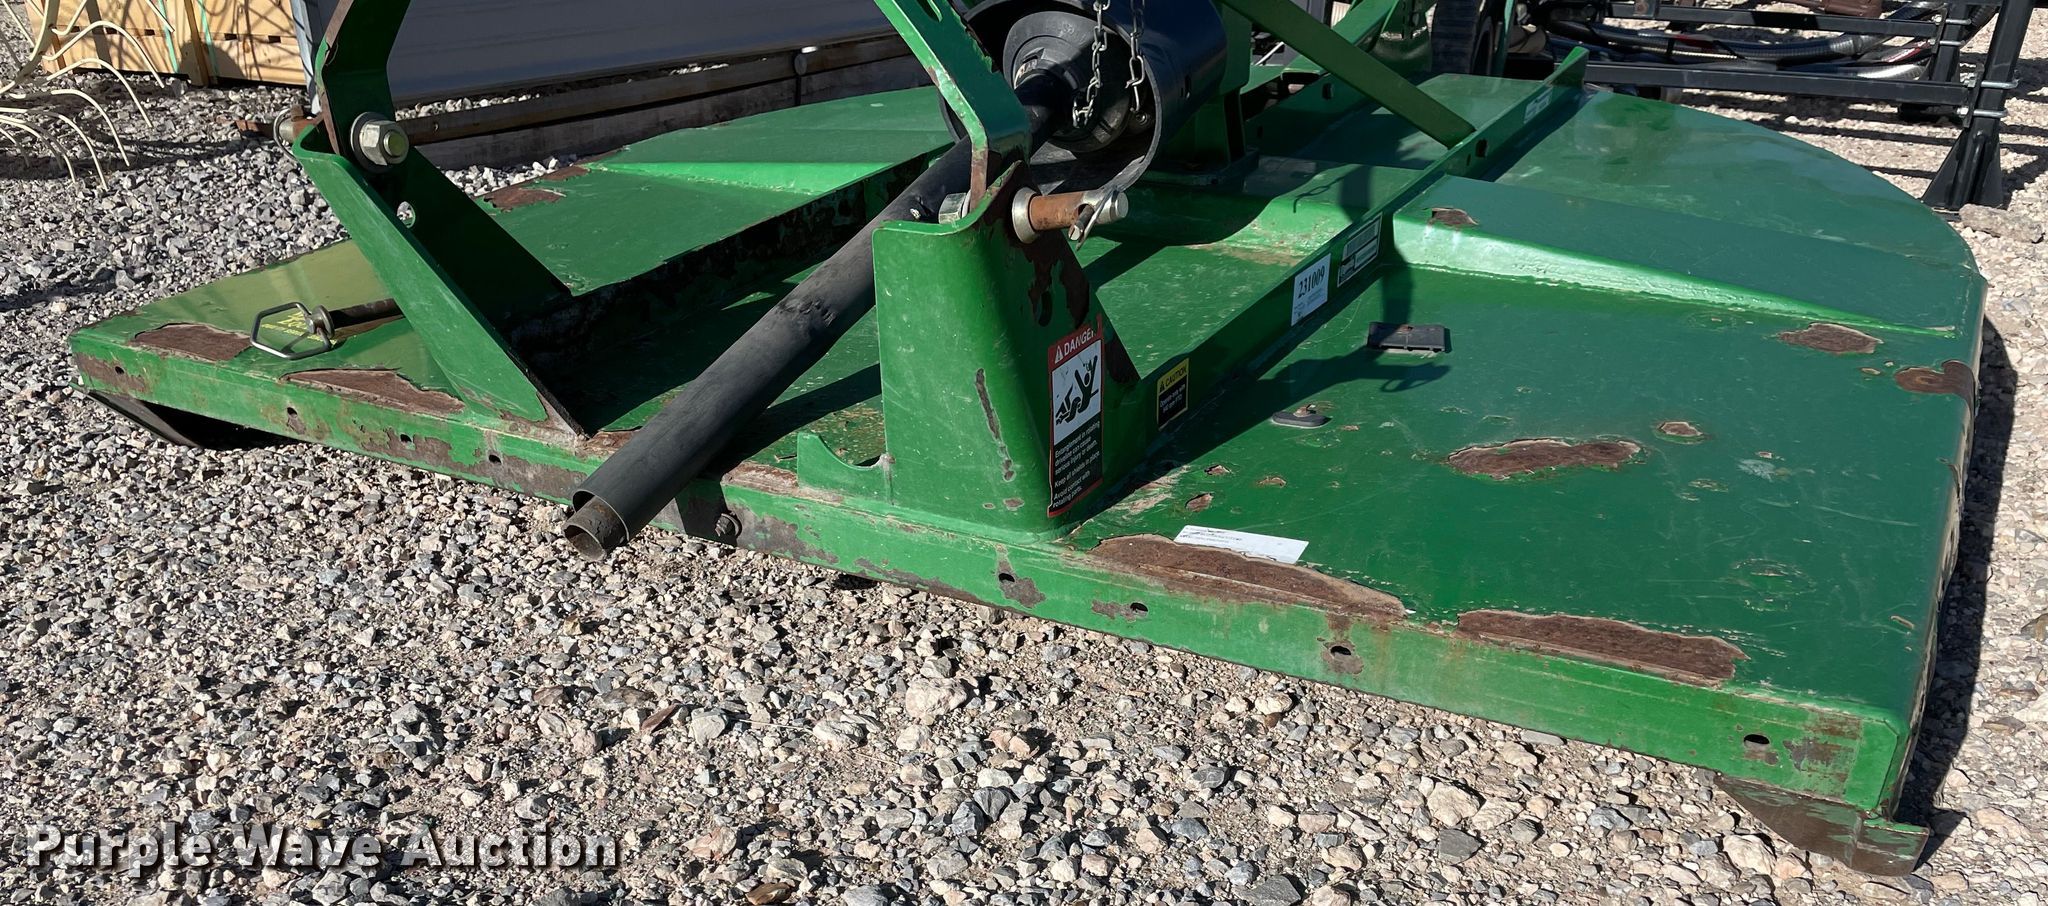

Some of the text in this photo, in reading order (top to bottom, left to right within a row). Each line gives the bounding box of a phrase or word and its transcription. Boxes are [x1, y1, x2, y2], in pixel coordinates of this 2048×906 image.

[1298, 265, 1325, 299] 231009
[1166, 367, 1186, 386] CAUTION
[1055, 434, 1081, 459] Entanglement
[1086, 420, 1100, 435] rotating
[1055, 450, 1072, 467] driveline
[1055, 460, 1070, 475] serious
[1055, 477, 1066, 488] Keep
[1072, 461, 1085, 476] shields
[1054, 487, 1067, 501] Avoid
[1067, 476, 1082, 492] contact
[1053, 493, 1072, 508] rotating
